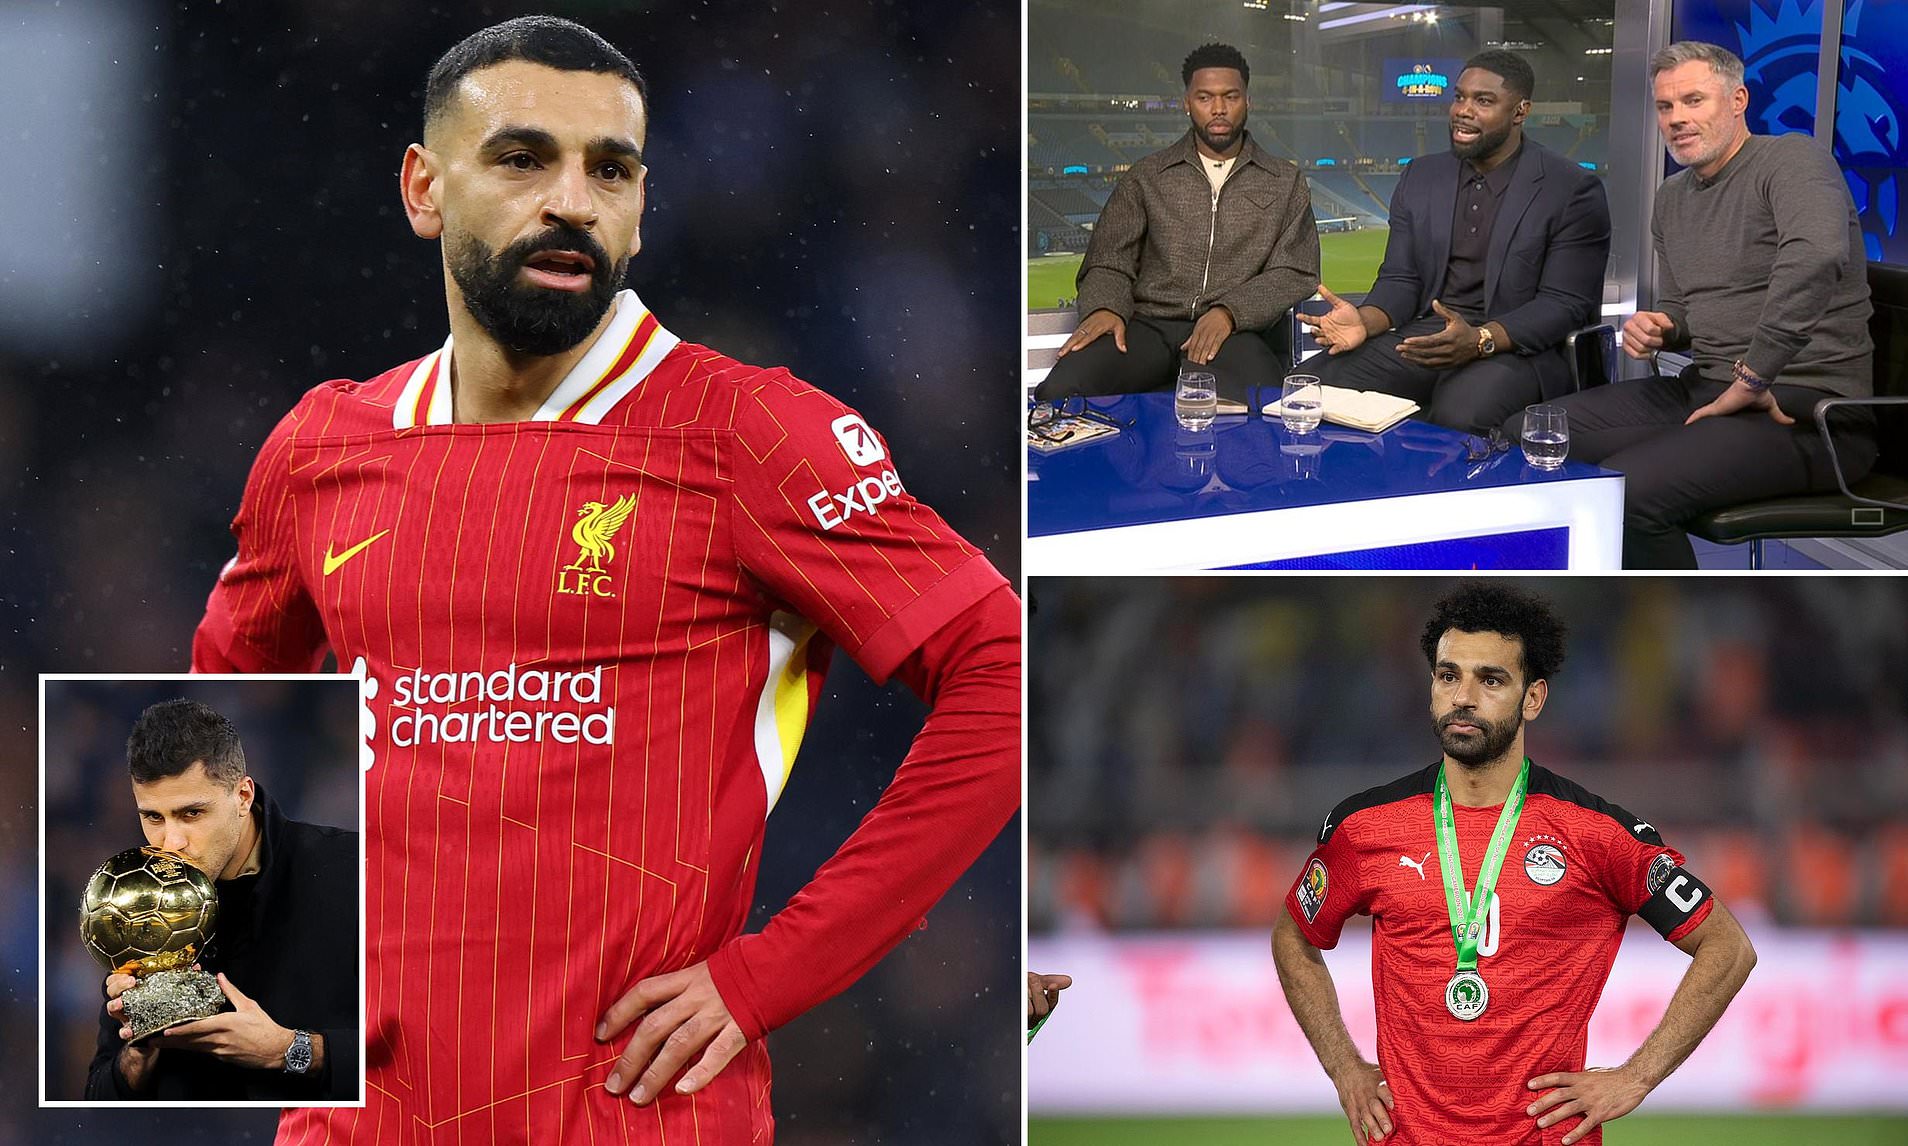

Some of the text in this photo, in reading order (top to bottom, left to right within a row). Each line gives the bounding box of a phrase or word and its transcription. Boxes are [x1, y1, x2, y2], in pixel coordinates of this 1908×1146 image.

[1397, 73, 1448, 88] CHAMPIONS
[807, 469, 906, 531] Expe
[393, 662, 602, 706] standard
[391, 704, 614, 747] chartered
[1665, 875, 1703, 913] C
